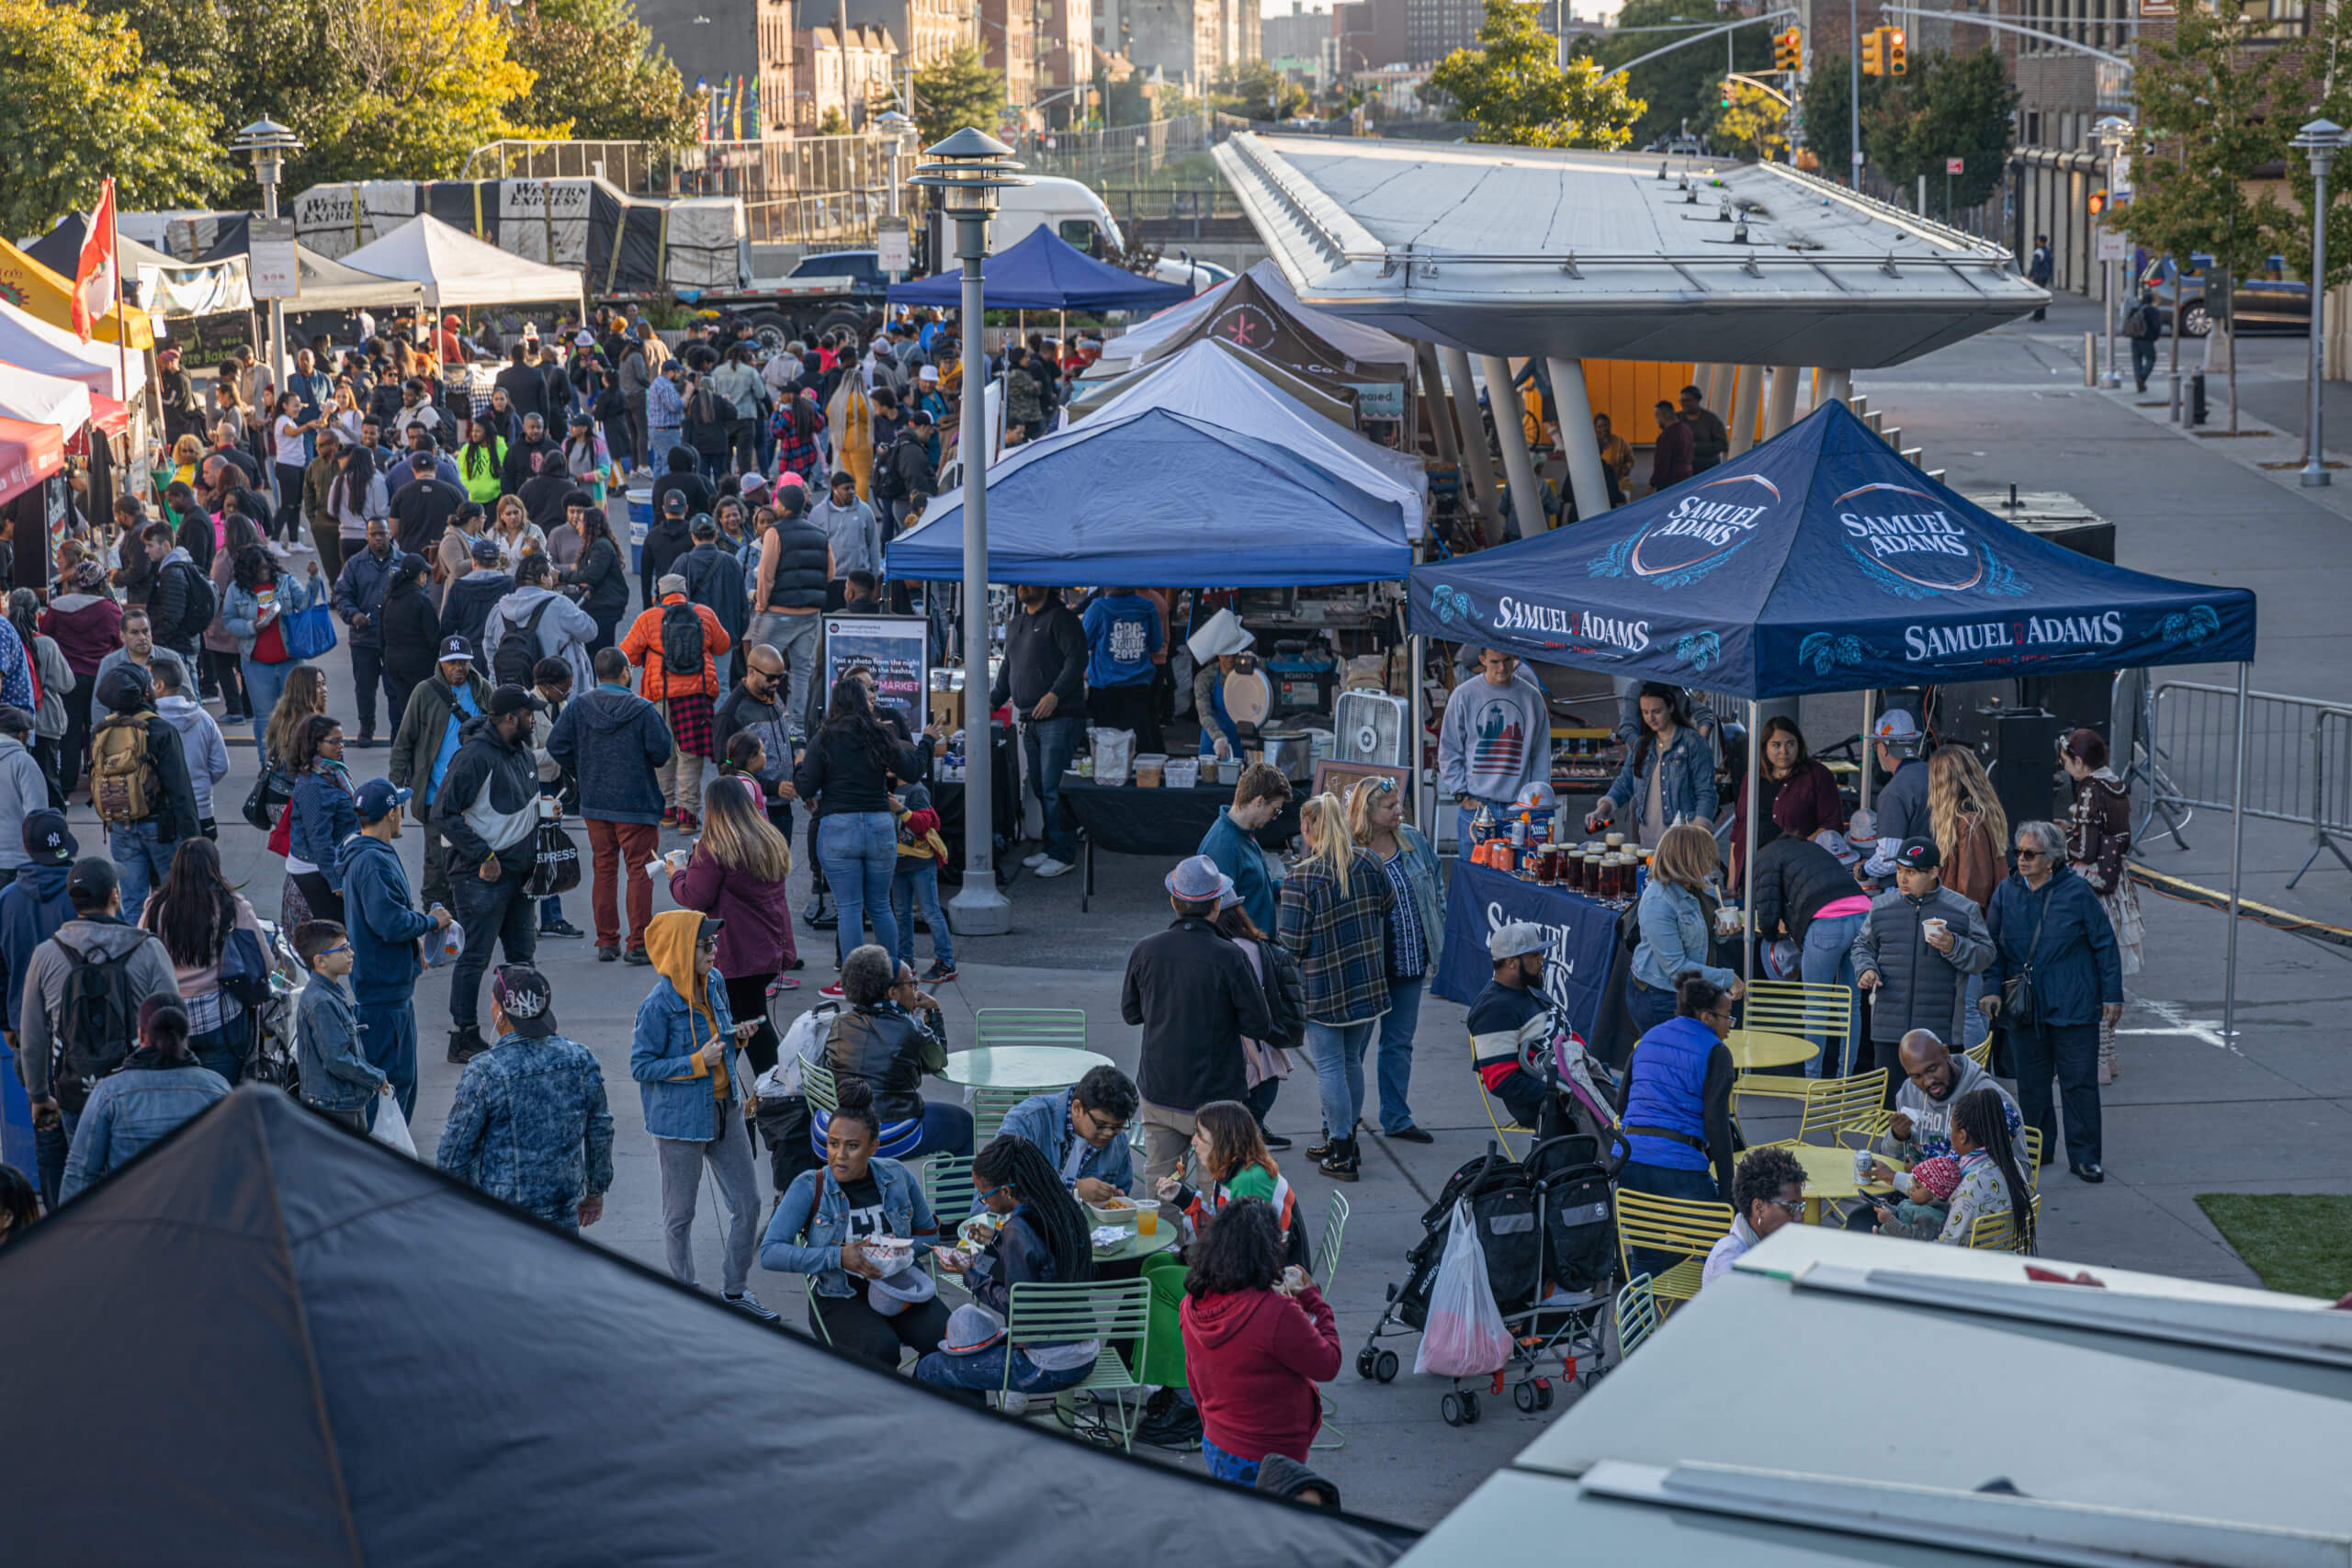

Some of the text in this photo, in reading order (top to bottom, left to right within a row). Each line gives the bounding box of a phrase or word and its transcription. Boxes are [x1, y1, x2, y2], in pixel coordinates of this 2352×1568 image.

[307, 197, 367, 212] WESTER
[510, 193, 579, 206] EXPESS
[303, 209, 368, 224] EXPRES
[1668, 496, 1768, 529] SAMUEL
[1839, 511, 1965, 537] SAMUEL
[1651, 518, 1740, 546] ADAMS
[1869, 534, 1970, 558] ADAMS
[1493, 596, 1650, 652] SAMUEL ADAMS
[1905, 611, 2123, 661] SAMUEL ADAMS
[853, 657, 872, 667] photo
[873, 657, 889, 665] from
[890, 657, 901, 665] the
[903, 659, 920, 668] night
[890, 666, 916, 677] hashtag
[537, 848, 577, 863] XPRESS
[1486, 901, 1574, 975] SUEL
[516, 988, 540, 1019] NY
